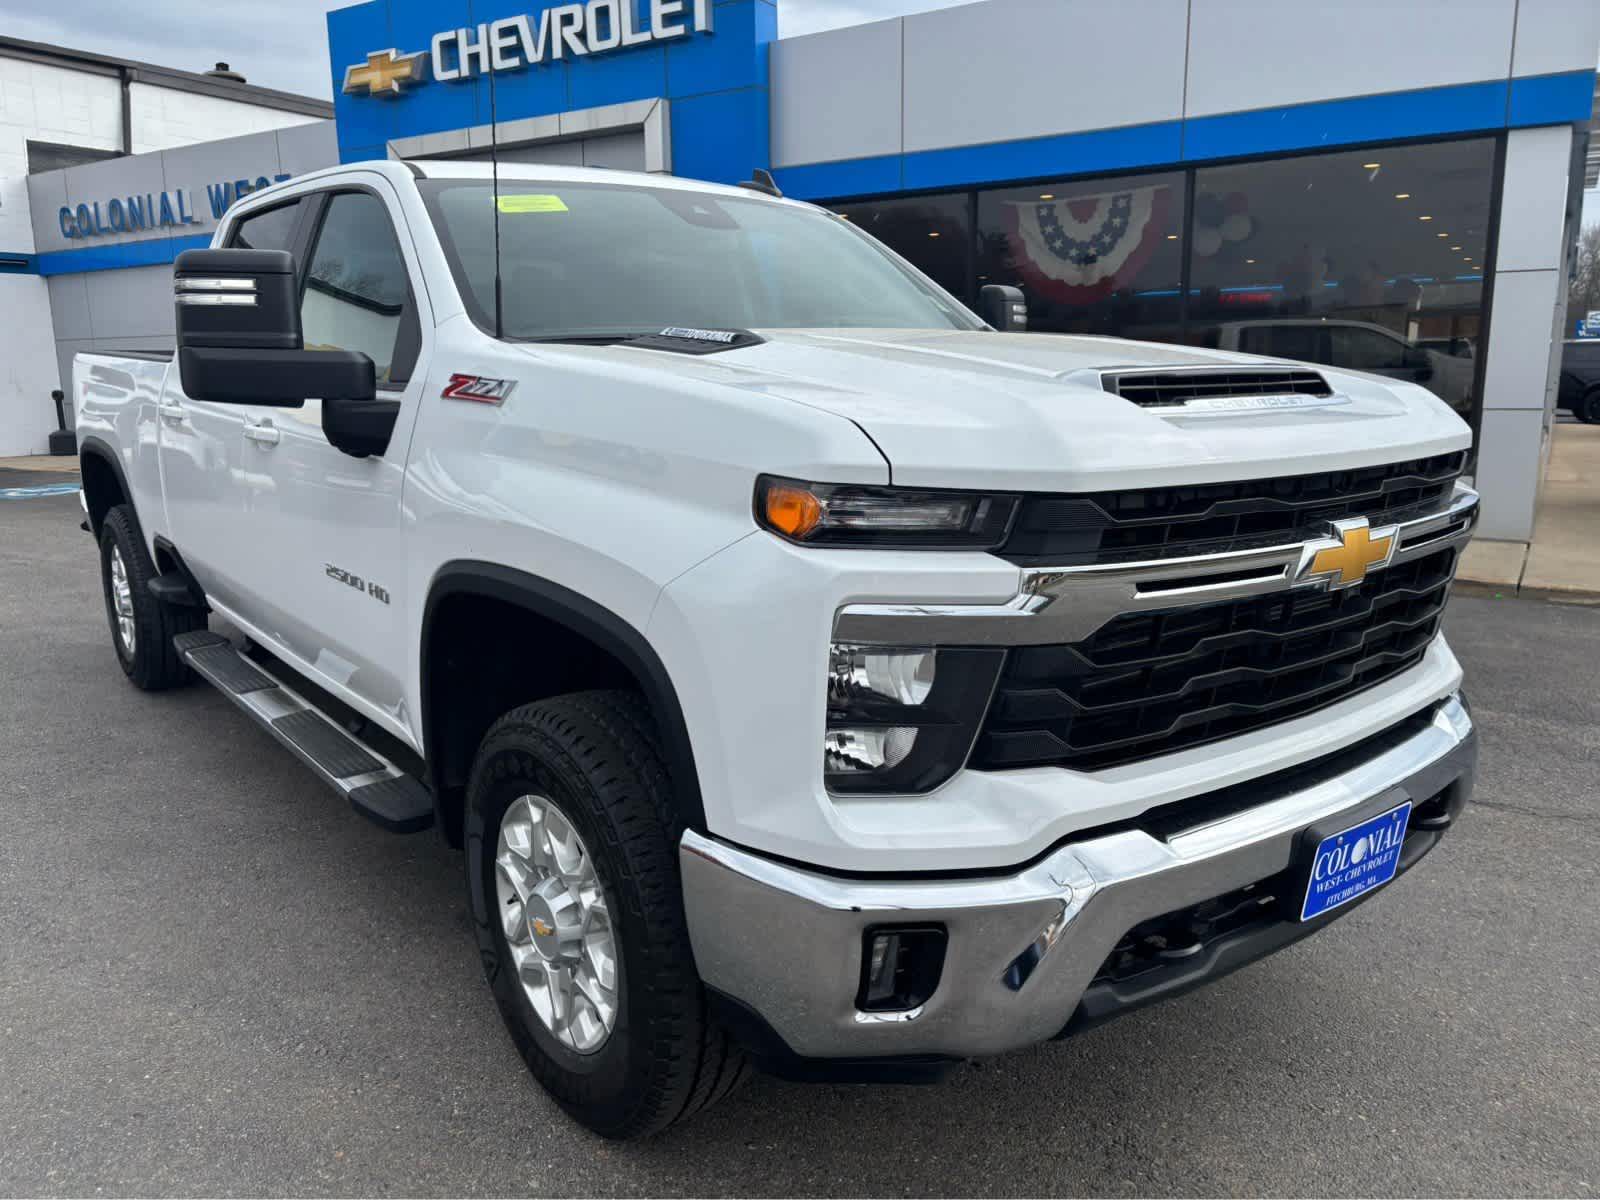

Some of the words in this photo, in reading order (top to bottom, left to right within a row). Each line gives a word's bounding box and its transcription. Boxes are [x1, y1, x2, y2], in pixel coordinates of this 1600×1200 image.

[58, 189, 195, 239] COLONIAL
[324, 562, 365, 592] 2500
[368, 582, 390, 605] HD
